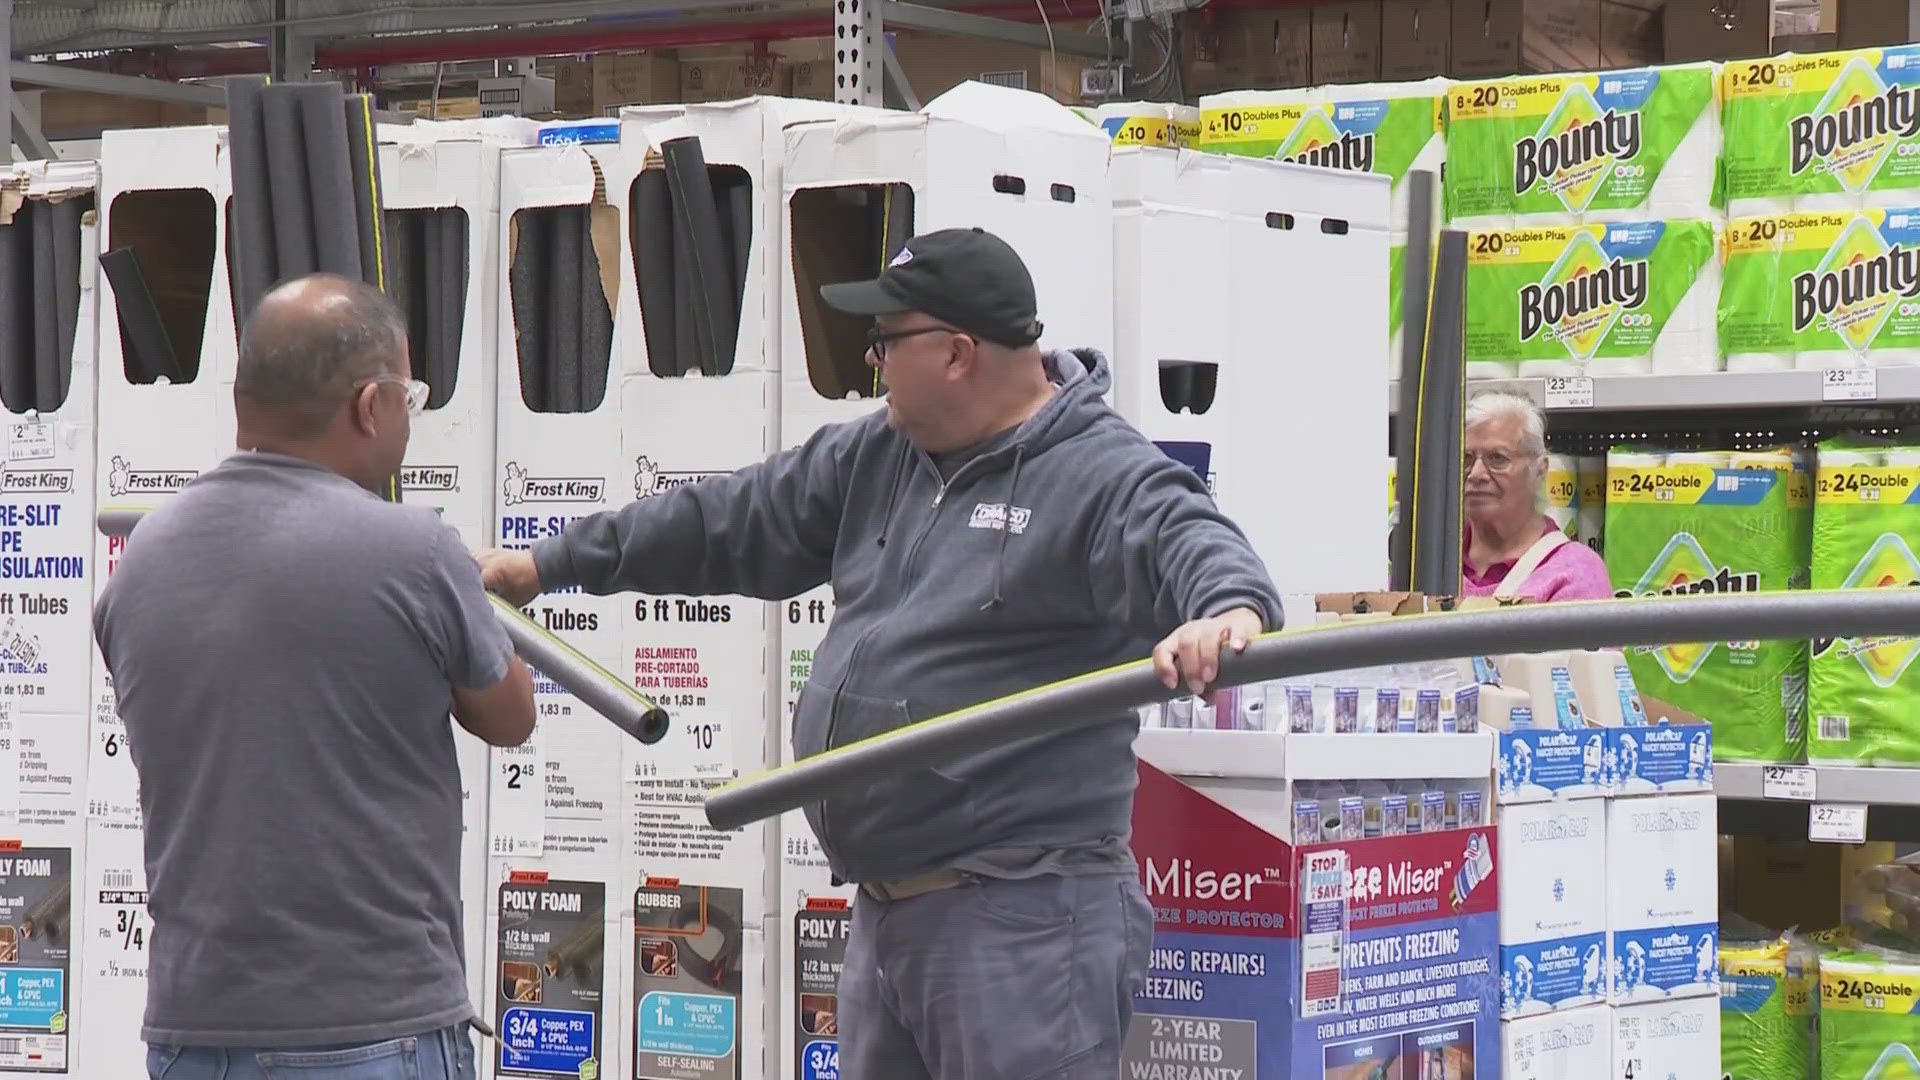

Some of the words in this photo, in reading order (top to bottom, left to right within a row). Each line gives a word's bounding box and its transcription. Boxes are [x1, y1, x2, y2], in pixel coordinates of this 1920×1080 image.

[1778, 63, 1816, 74] Doubles
[1819, 58, 1840, 68] Plus
[1502, 86, 1537, 97] Doubles
[1540, 83, 1560, 94] Plus
[1243, 111, 1279, 122] Doubles
[1282, 109, 1301, 119] Plus
[1790, 85, 1920, 175] Bounty
[1515, 109, 1640, 195] Bounty
[1779, 217, 1819, 230] Doubles
[1821, 215, 1842, 226] Plus
[1504, 232, 1543, 243] Doubles
[1545, 230, 1566, 241] Plus
[1794, 244, 1920, 331] Bounty
[1519, 258, 1647, 341] Bounty
[4, 474, 38, 487] Frost
[39, 473, 69, 489] King
[128, 474, 163, 489] Frost
[1656, 475, 1701, 488] Double
[1860, 474, 1909, 487] Double
[525, 483, 563, 497] Frost
[565, 483, 599, 499] King
[1, 593, 13, 614] ft
[20, 593, 68, 615] Tubes
[635, 600, 647, 622] 6
[654, 599, 669, 622] ft
[676, 600, 731, 622] Tubes
[543, 608, 598, 631] Tubes
[788, 601, 801, 624] 6
[808, 601, 825, 624] ft
[635, 648, 697, 660] AISLAMIENTO
[635, 662, 699, 673] PRE-CORTADO
[635, 677, 661, 689] PARA
[663, 675, 709, 689] TUBERÍAS
[4, 684, 14, 695] de
[17, 684, 34, 697] 1,83
[37, 686, 45, 695] m
[659, 694, 671, 706] de
[675, 694, 694, 708] 1,83
[696, 697, 706, 706] m
[540, 703, 559, 717] 1,83
[562, 705, 571, 715] m
[16, 859, 51, 877] FOAM
[1312, 858, 1336, 873] STOP
[638, 892, 681, 908] RUBBER
[1317, 885, 1342, 899] SAVE
[503, 891, 537, 910] POLY
[541, 891, 581, 912] FOAM
[1186, 909, 1285, 930] PROTECTOR
[99, 928, 111, 938] Fits
[531, 931, 551, 943] wall
[800, 919, 836, 939] POLY
[1343, 936, 1402, 970] PREVENTS
[1405, 927, 1460, 962] FREEZING
[1191, 950, 1265, 976] REPAIRS!
[122, 968, 137, 977] IRON
[1864, 981, 1912, 996] Double
[1356, 996, 1378, 1014] WATER
[1379, 991, 1400, 1010] WELLS
[655, 1006, 663, 1026] 1
[1317, 1024, 1335, 1040] EVEN
[1345, 1020, 1358, 1034] THE
[1409, 1003, 1440, 1022] FREEZING
[510, 1017, 538, 1037] 3/4
[541, 1019, 569, 1033] Copper,
[570, 1020, 584, 1032] PEX
[1151, 1018, 1221, 1041] 2-YEAR
[512, 1036, 535, 1049] inch
[541, 1032, 547, 1043] &
[548, 1033, 568, 1044] CPVC
[1150, 1040, 1223, 1063] LIMITED
[657, 1056, 715, 1071] SELF-SEALING
[1130, 1061, 1243, 1080] WARRANTY
